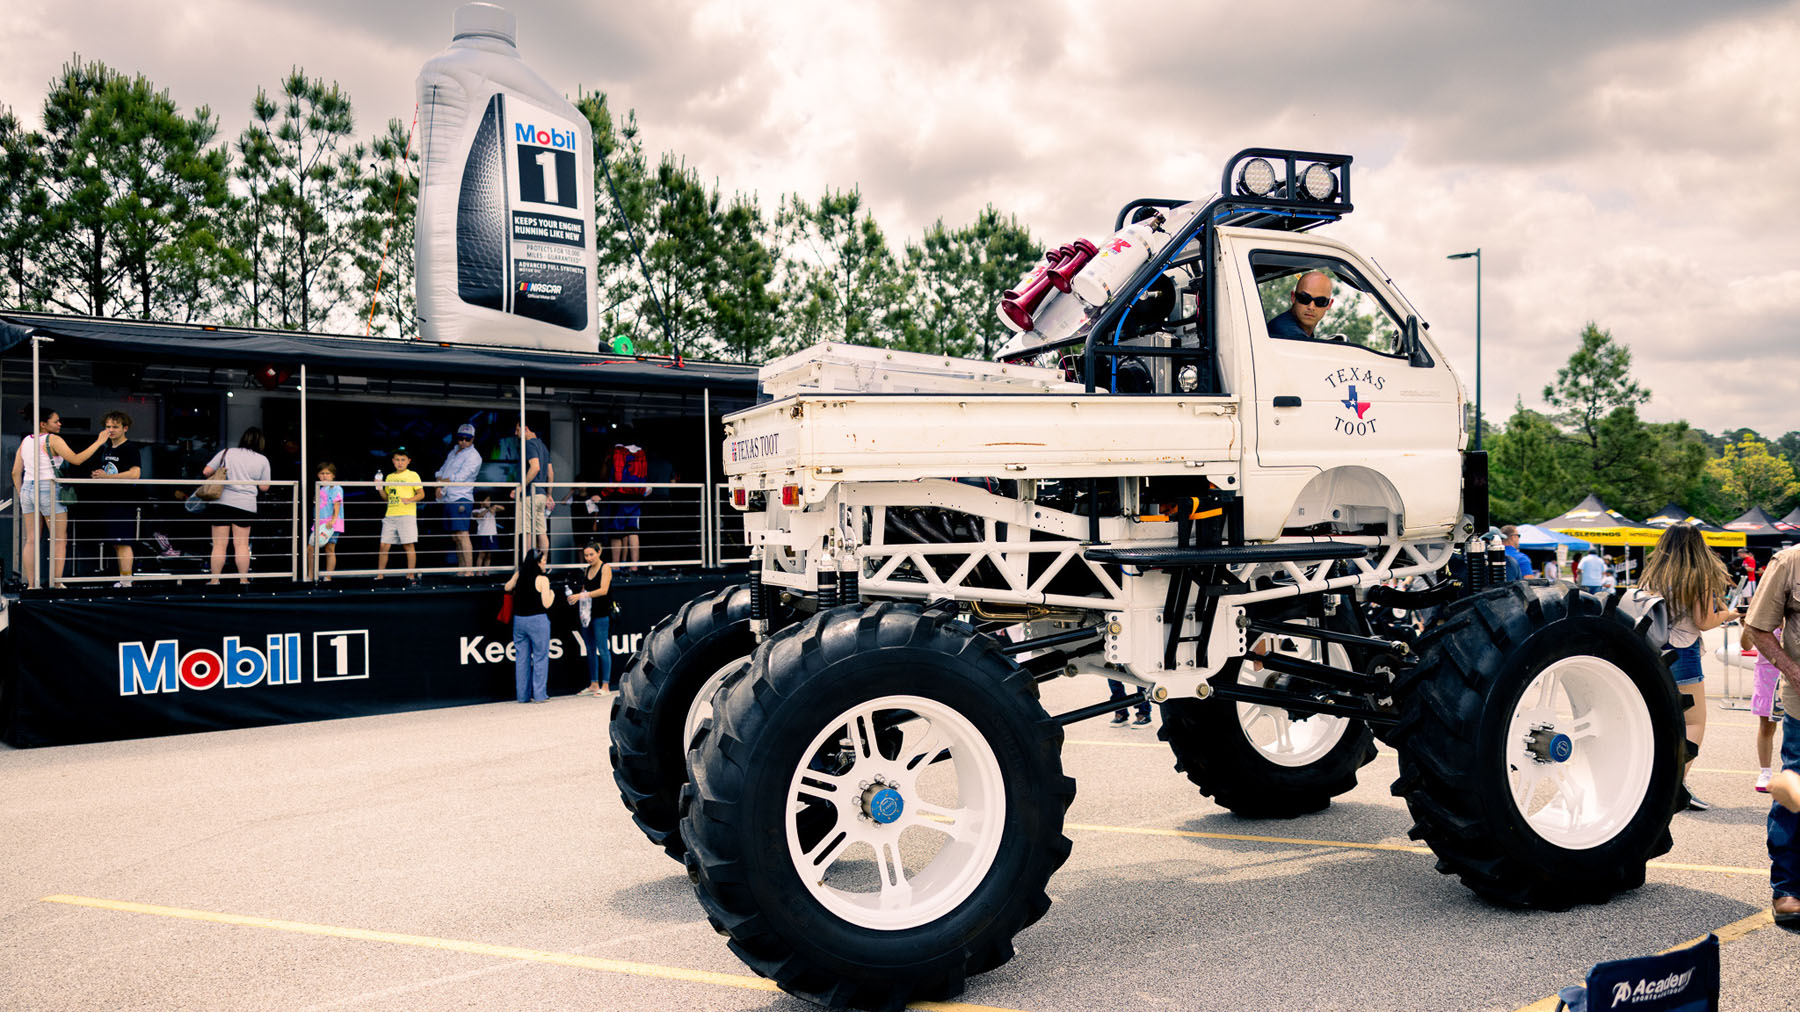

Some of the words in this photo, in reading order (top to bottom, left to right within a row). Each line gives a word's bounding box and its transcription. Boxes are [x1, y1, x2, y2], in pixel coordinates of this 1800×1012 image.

[516, 123, 576, 150] Mobil
[536, 151, 559, 203] 1
[514, 216, 537, 226] KEEPS
[538, 219, 557, 229] YOUR
[559, 222, 582, 233] ENGINE
[515, 226, 548, 236] RUNNING
[550, 229, 564, 239] LIKE
[565, 232, 580, 241] NEW
[527, 245, 552, 253] PROTECTS
[519, 261, 546, 270] ADVANCED
[560, 265, 584, 274] SYNTHETIC
[530, 283, 562, 294] NASCAR
[1325, 368, 1385, 390] TEXAS
[1335, 416, 1376, 436] TOOT
[737, 437, 759, 461] TEXAS
[760, 433, 779, 456] TOOT
[460, 636, 563, 665] Kees
[572, 630, 642, 657] Yur
[118, 633, 301, 696] Mobil
[330, 635, 348, 675] 1
[1632, 966, 1696, 996] Academy
